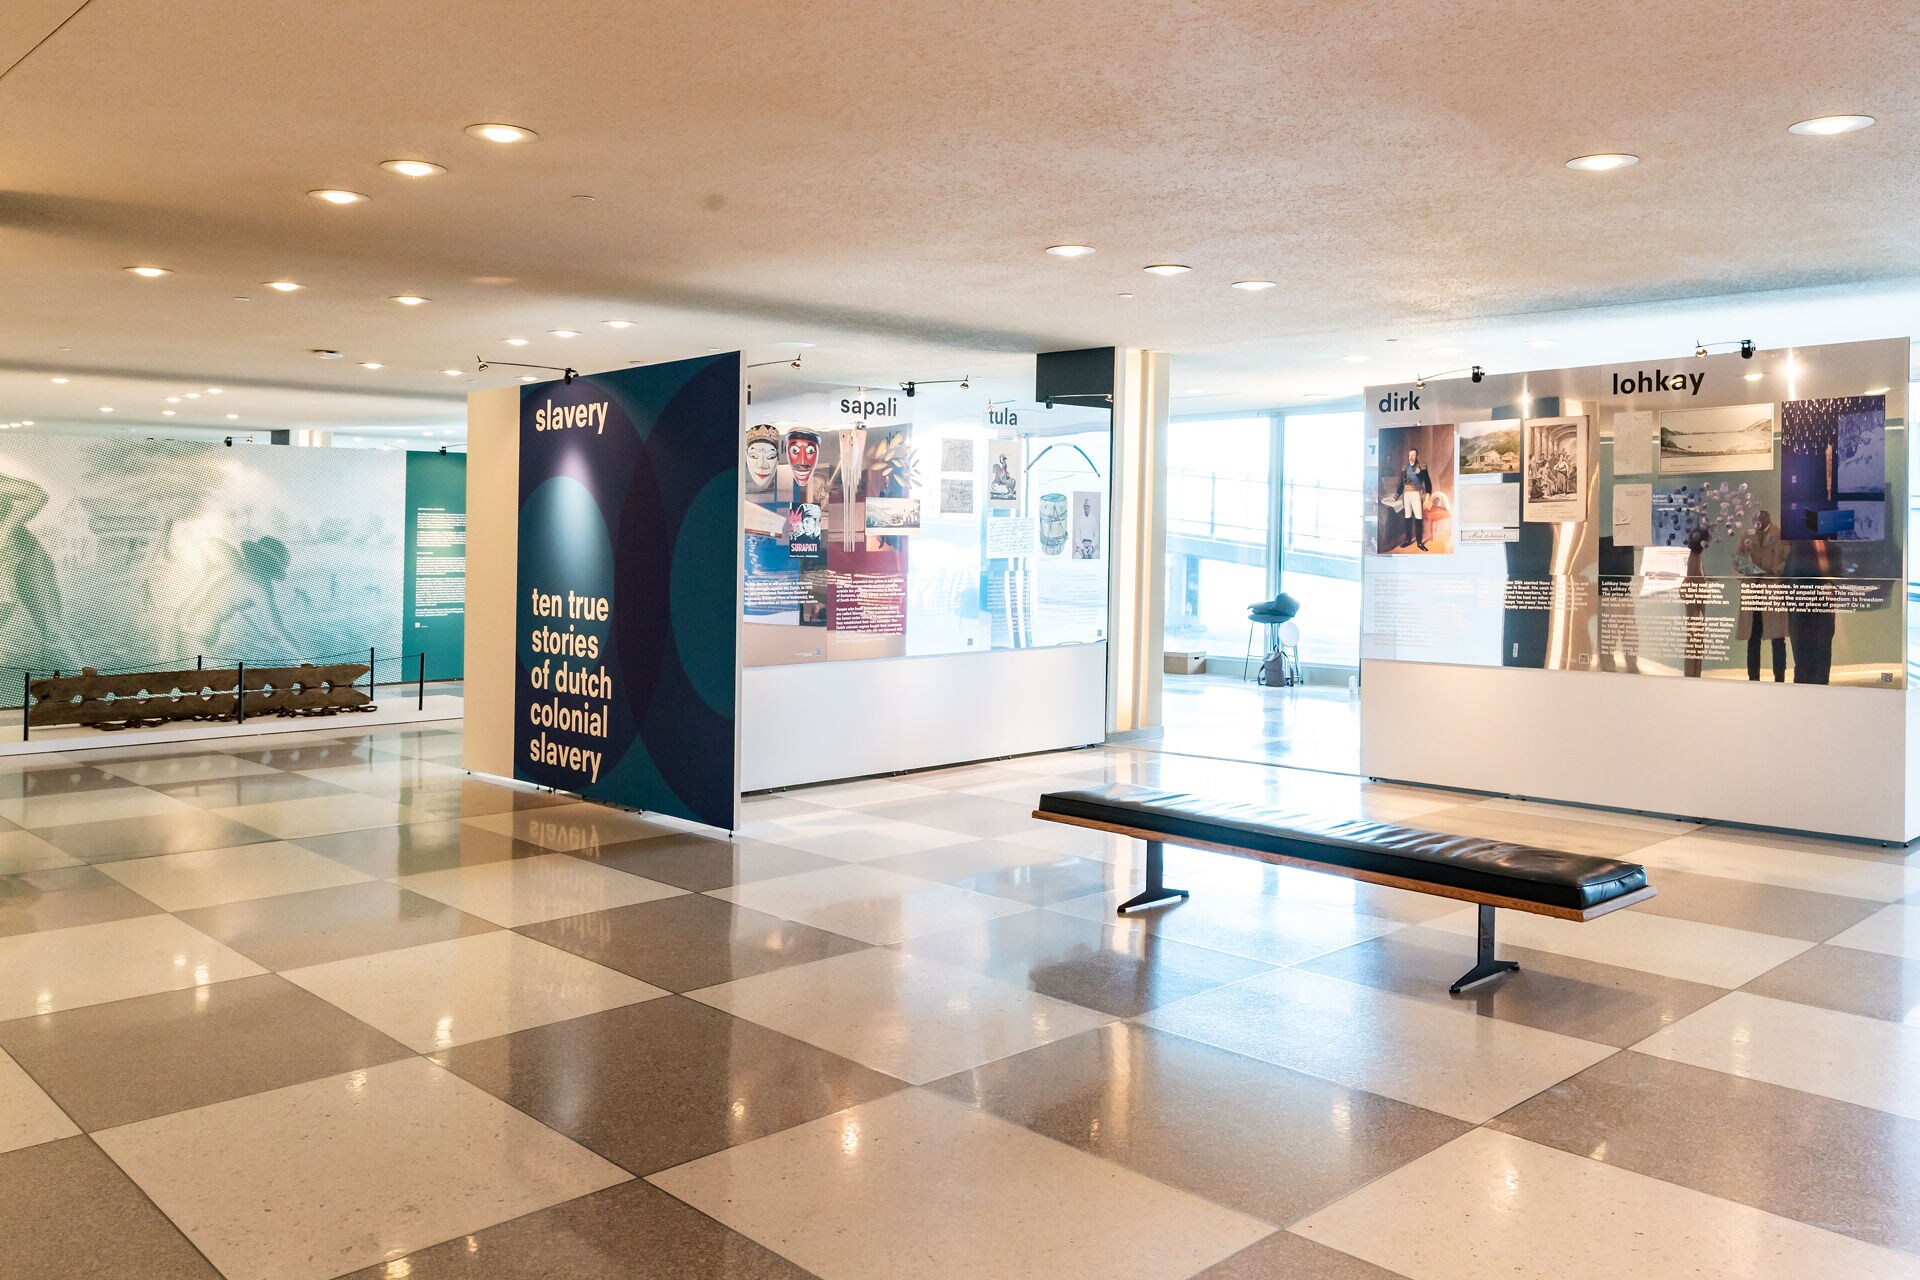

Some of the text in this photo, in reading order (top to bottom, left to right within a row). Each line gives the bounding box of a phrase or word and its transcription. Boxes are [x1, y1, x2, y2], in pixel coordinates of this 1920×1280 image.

[1613, 370, 1705, 395] lohkay
[535, 399, 609, 435] slavery
[840, 398, 897, 420] sapali
[989, 408, 1018, 426] tula
[1378, 390, 1421, 413] dirk
[791, 543, 818, 552] SURAPATI
[532, 588, 609, 622] ten true
[531, 624, 599, 660] stories
[531, 658, 612, 700] of dutch
[530, 697, 608, 738] colonial
[529, 731, 602, 784] slavery
